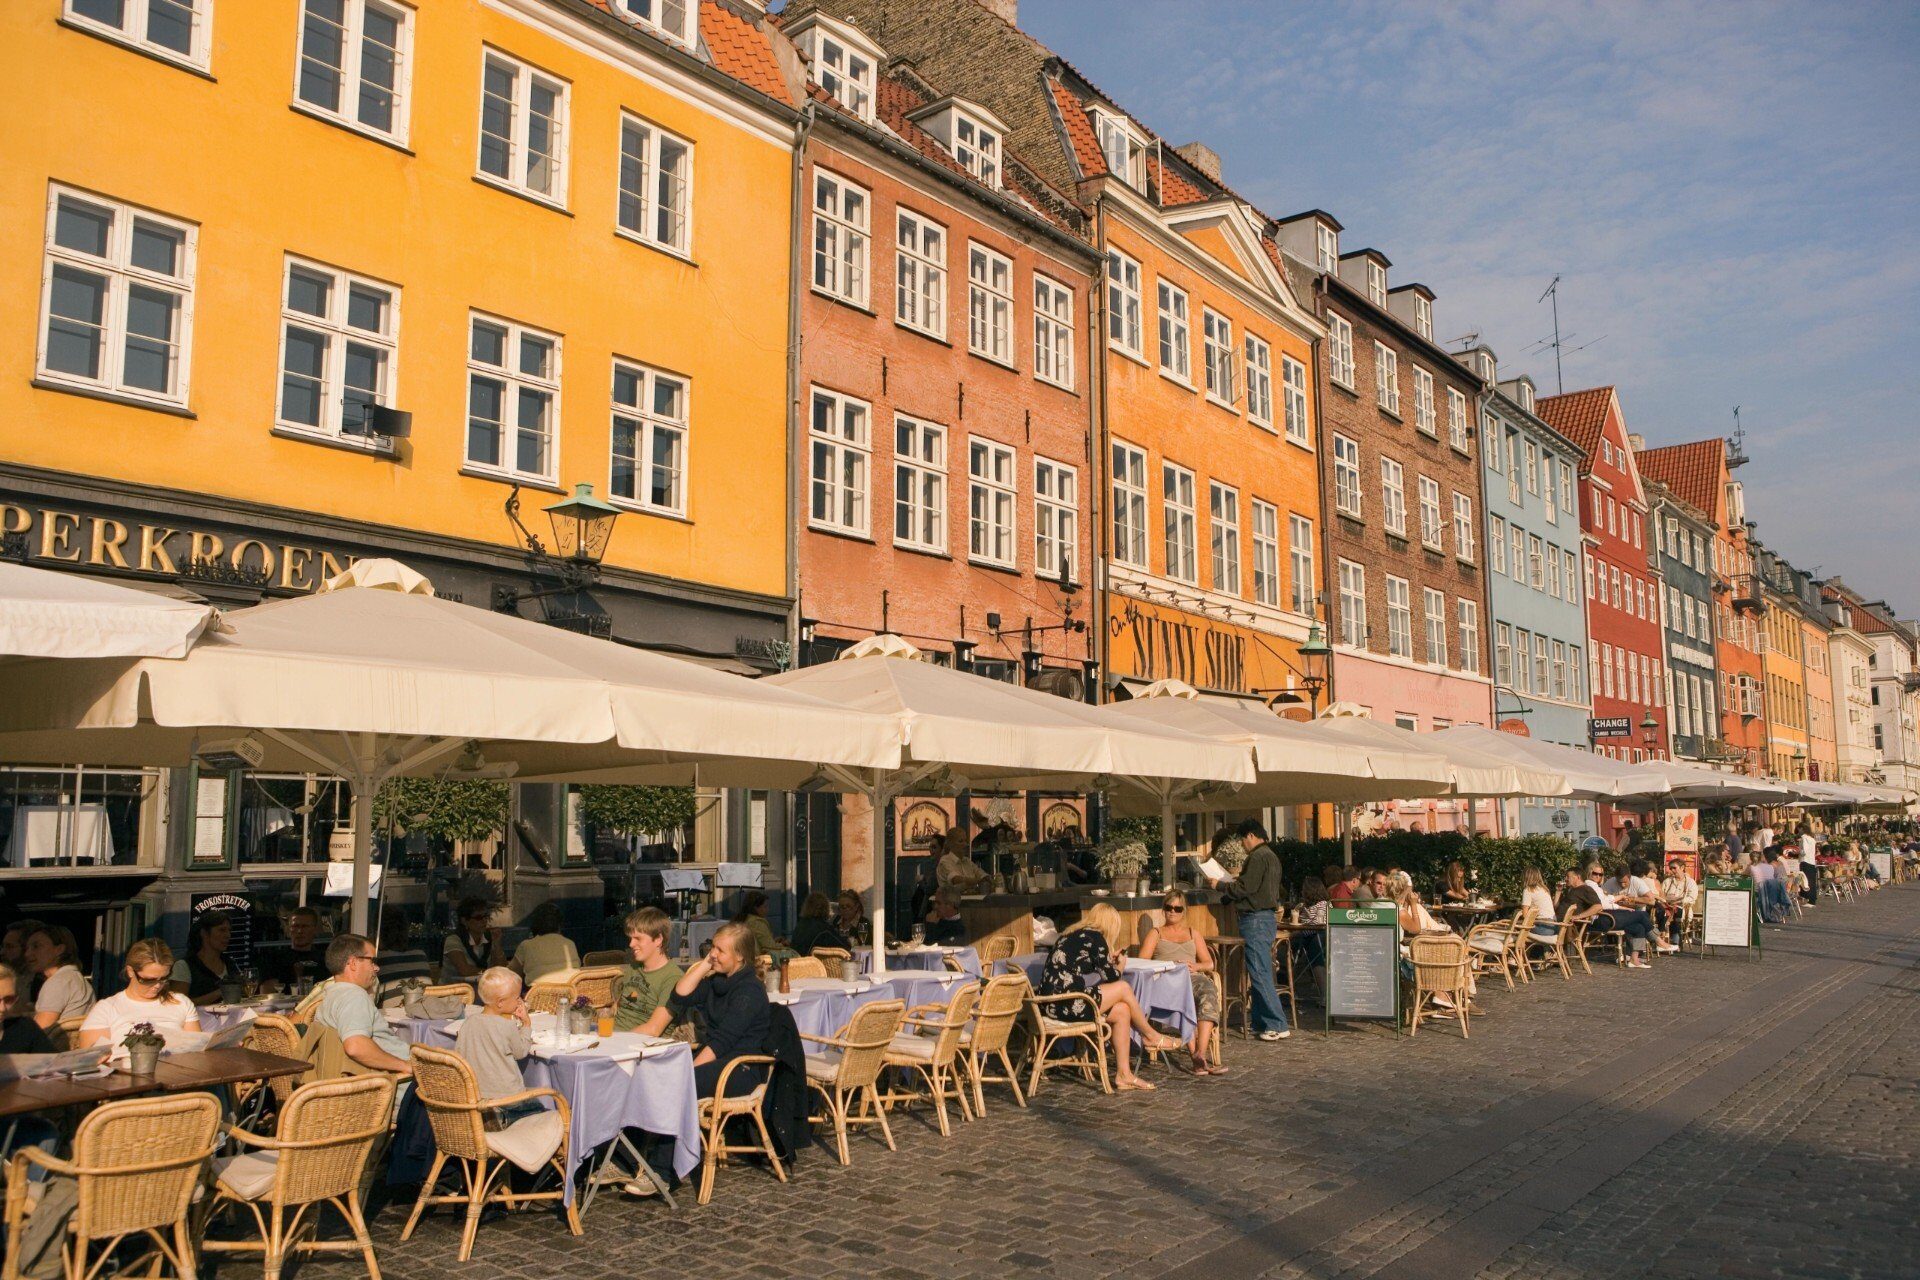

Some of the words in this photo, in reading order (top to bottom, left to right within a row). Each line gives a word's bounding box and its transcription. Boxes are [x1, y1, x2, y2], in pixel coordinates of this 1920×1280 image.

[1110, 615, 1126, 637] On
[1132, 614, 1199, 687] SUNNY
[1204, 628, 1247, 694] SIDE
[1594, 719, 1628, 728] CHANGE
[194, 894, 251, 913] FROKOSTRETTER
[1345, 909, 1378, 923] Carlsberg
